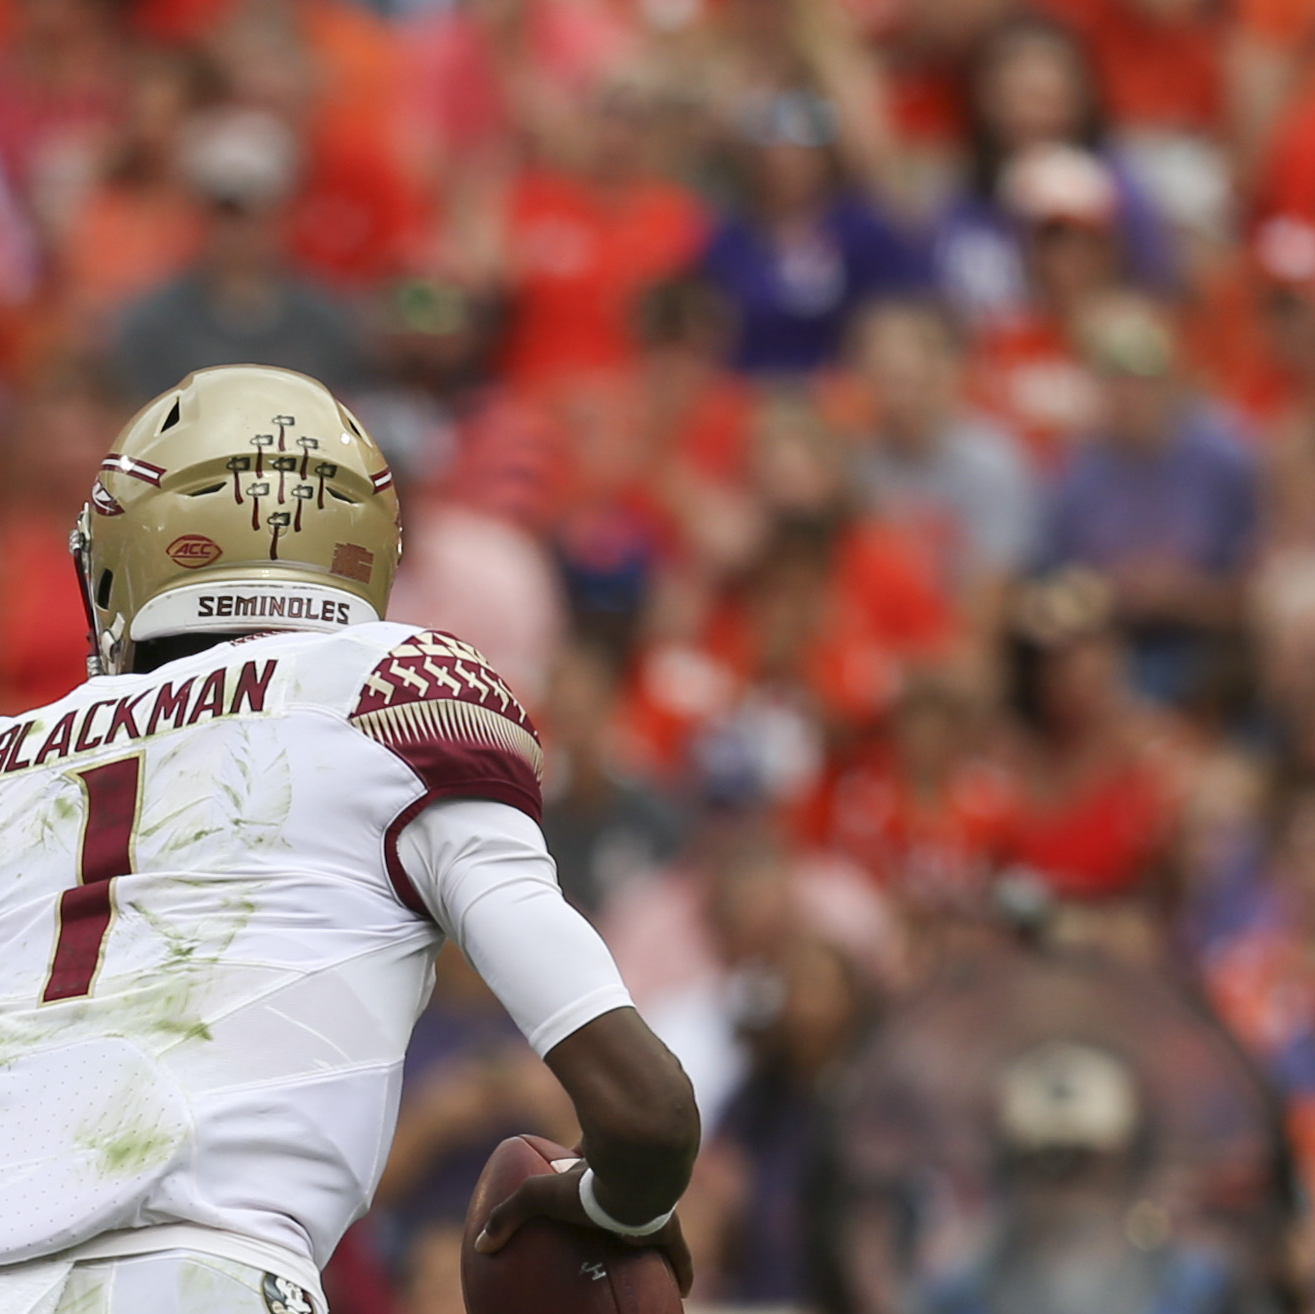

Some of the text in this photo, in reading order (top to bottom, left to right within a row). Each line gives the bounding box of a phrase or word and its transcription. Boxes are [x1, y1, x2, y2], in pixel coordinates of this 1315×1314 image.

[174, 541, 213, 556] ACC
[198, 594, 350, 625] SEMINOLES
[37, 748, 147, 1008] 1
